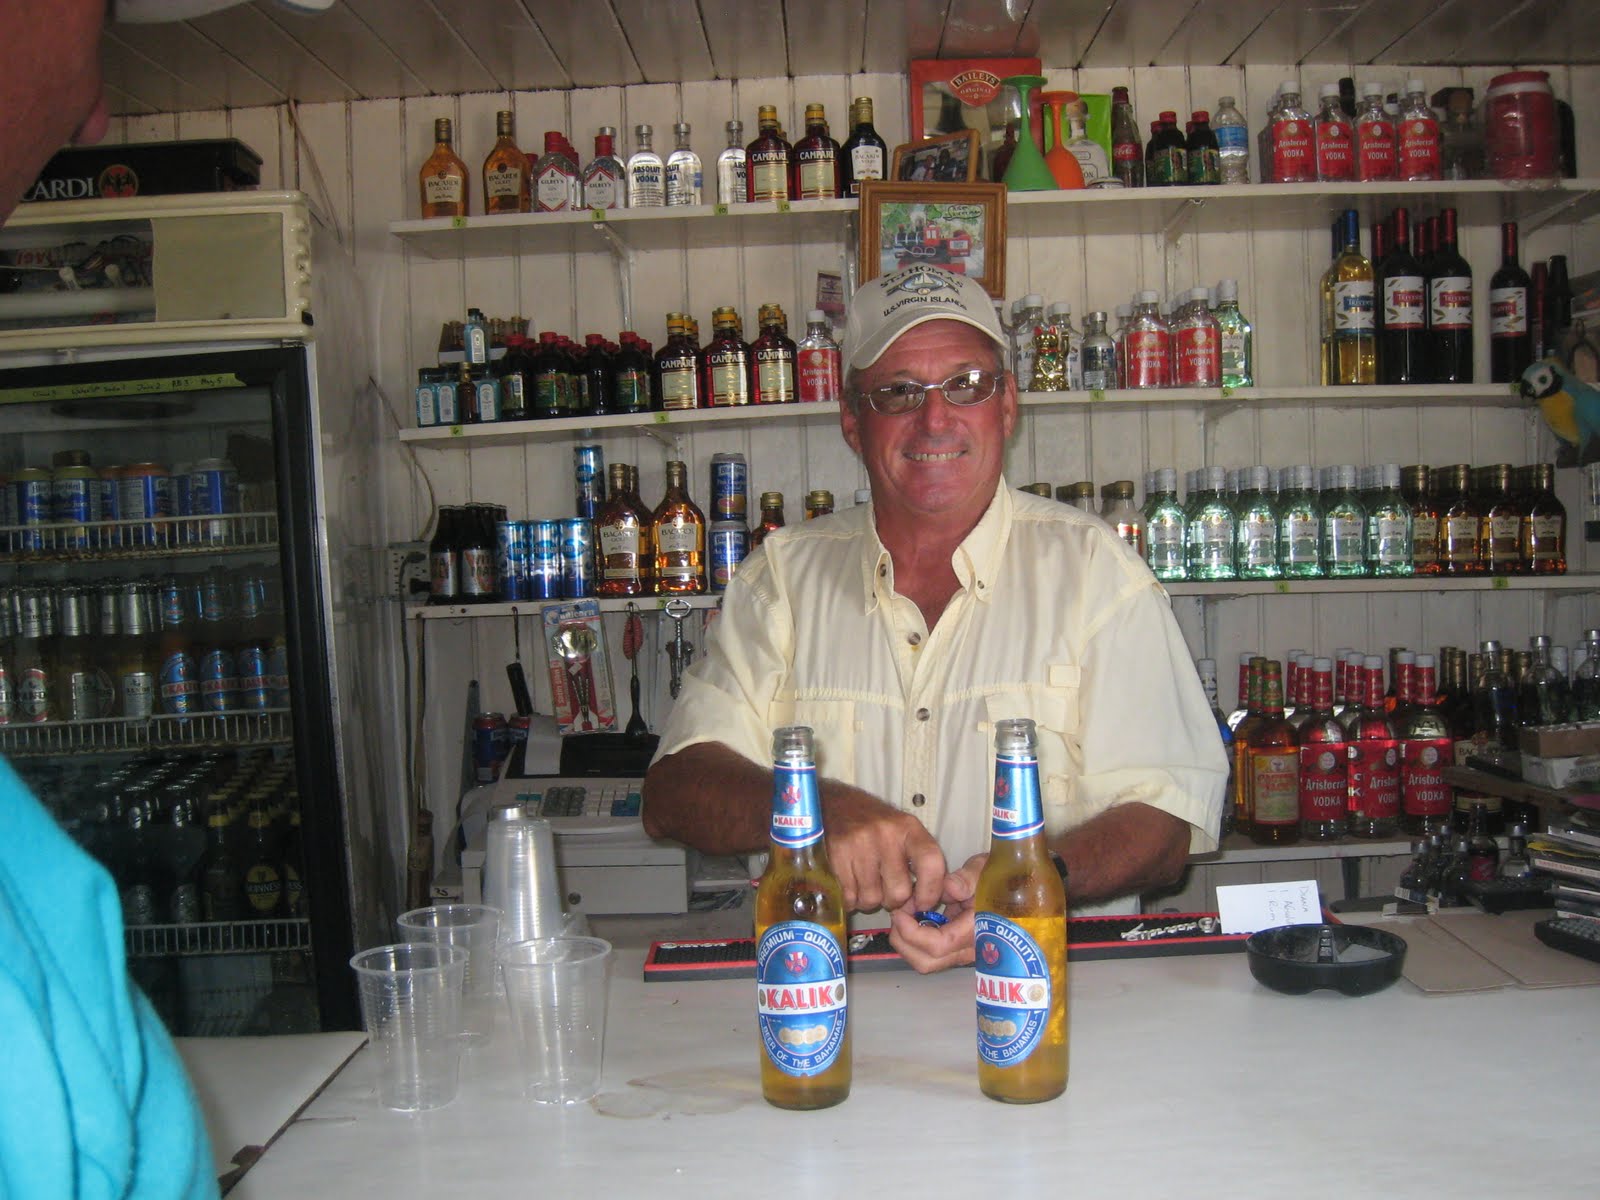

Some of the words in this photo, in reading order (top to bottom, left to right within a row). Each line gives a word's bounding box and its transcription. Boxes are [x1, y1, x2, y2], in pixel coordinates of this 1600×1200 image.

[954, 72, 997, 86] BAILEYS
[752, 152, 788, 162] CAMPARI
[800, 150, 834, 160] CAMPARI
[1282, 150, 1304, 158] VODKA
[1326, 152, 1346, 160] VODKA
[1368, 152, 1388, 160] VODKA
[1409, 150, 1430, 158] VODKA
[632, 166, 661, 174] ABSOLUT
[635, 174, 659, 184] VODKA
[24, 178, 94, 201] ARDI
[711, 354, 746, 364] CAMPARI
[758, 351, 792, 361] CAMPARI
[660, 360, 694, 370] CAMPARI
[1313, 796, 1341, 806] VODKA
[1416, 791, 1444, 802] VODKA
[778, 816, 804, 826] KALIK
[758, 930, 795, 966] PREMIUM
[804, 931, 841, 964] QUALITY
[996, 925, 1037, 963] QUALITY
[766, 985, 835, 1010] KALIK
[762, 1025, 776, 1050] BEER
[776, 1051, 788, 1062] OF
[792, 1058, 811, 1068] THE
[815, 1020, 842, 1062] BAHAMAS
[985, 1047, 998, 1059] THE
[1003, 1020, 1038, 1058] BAHAMAS
